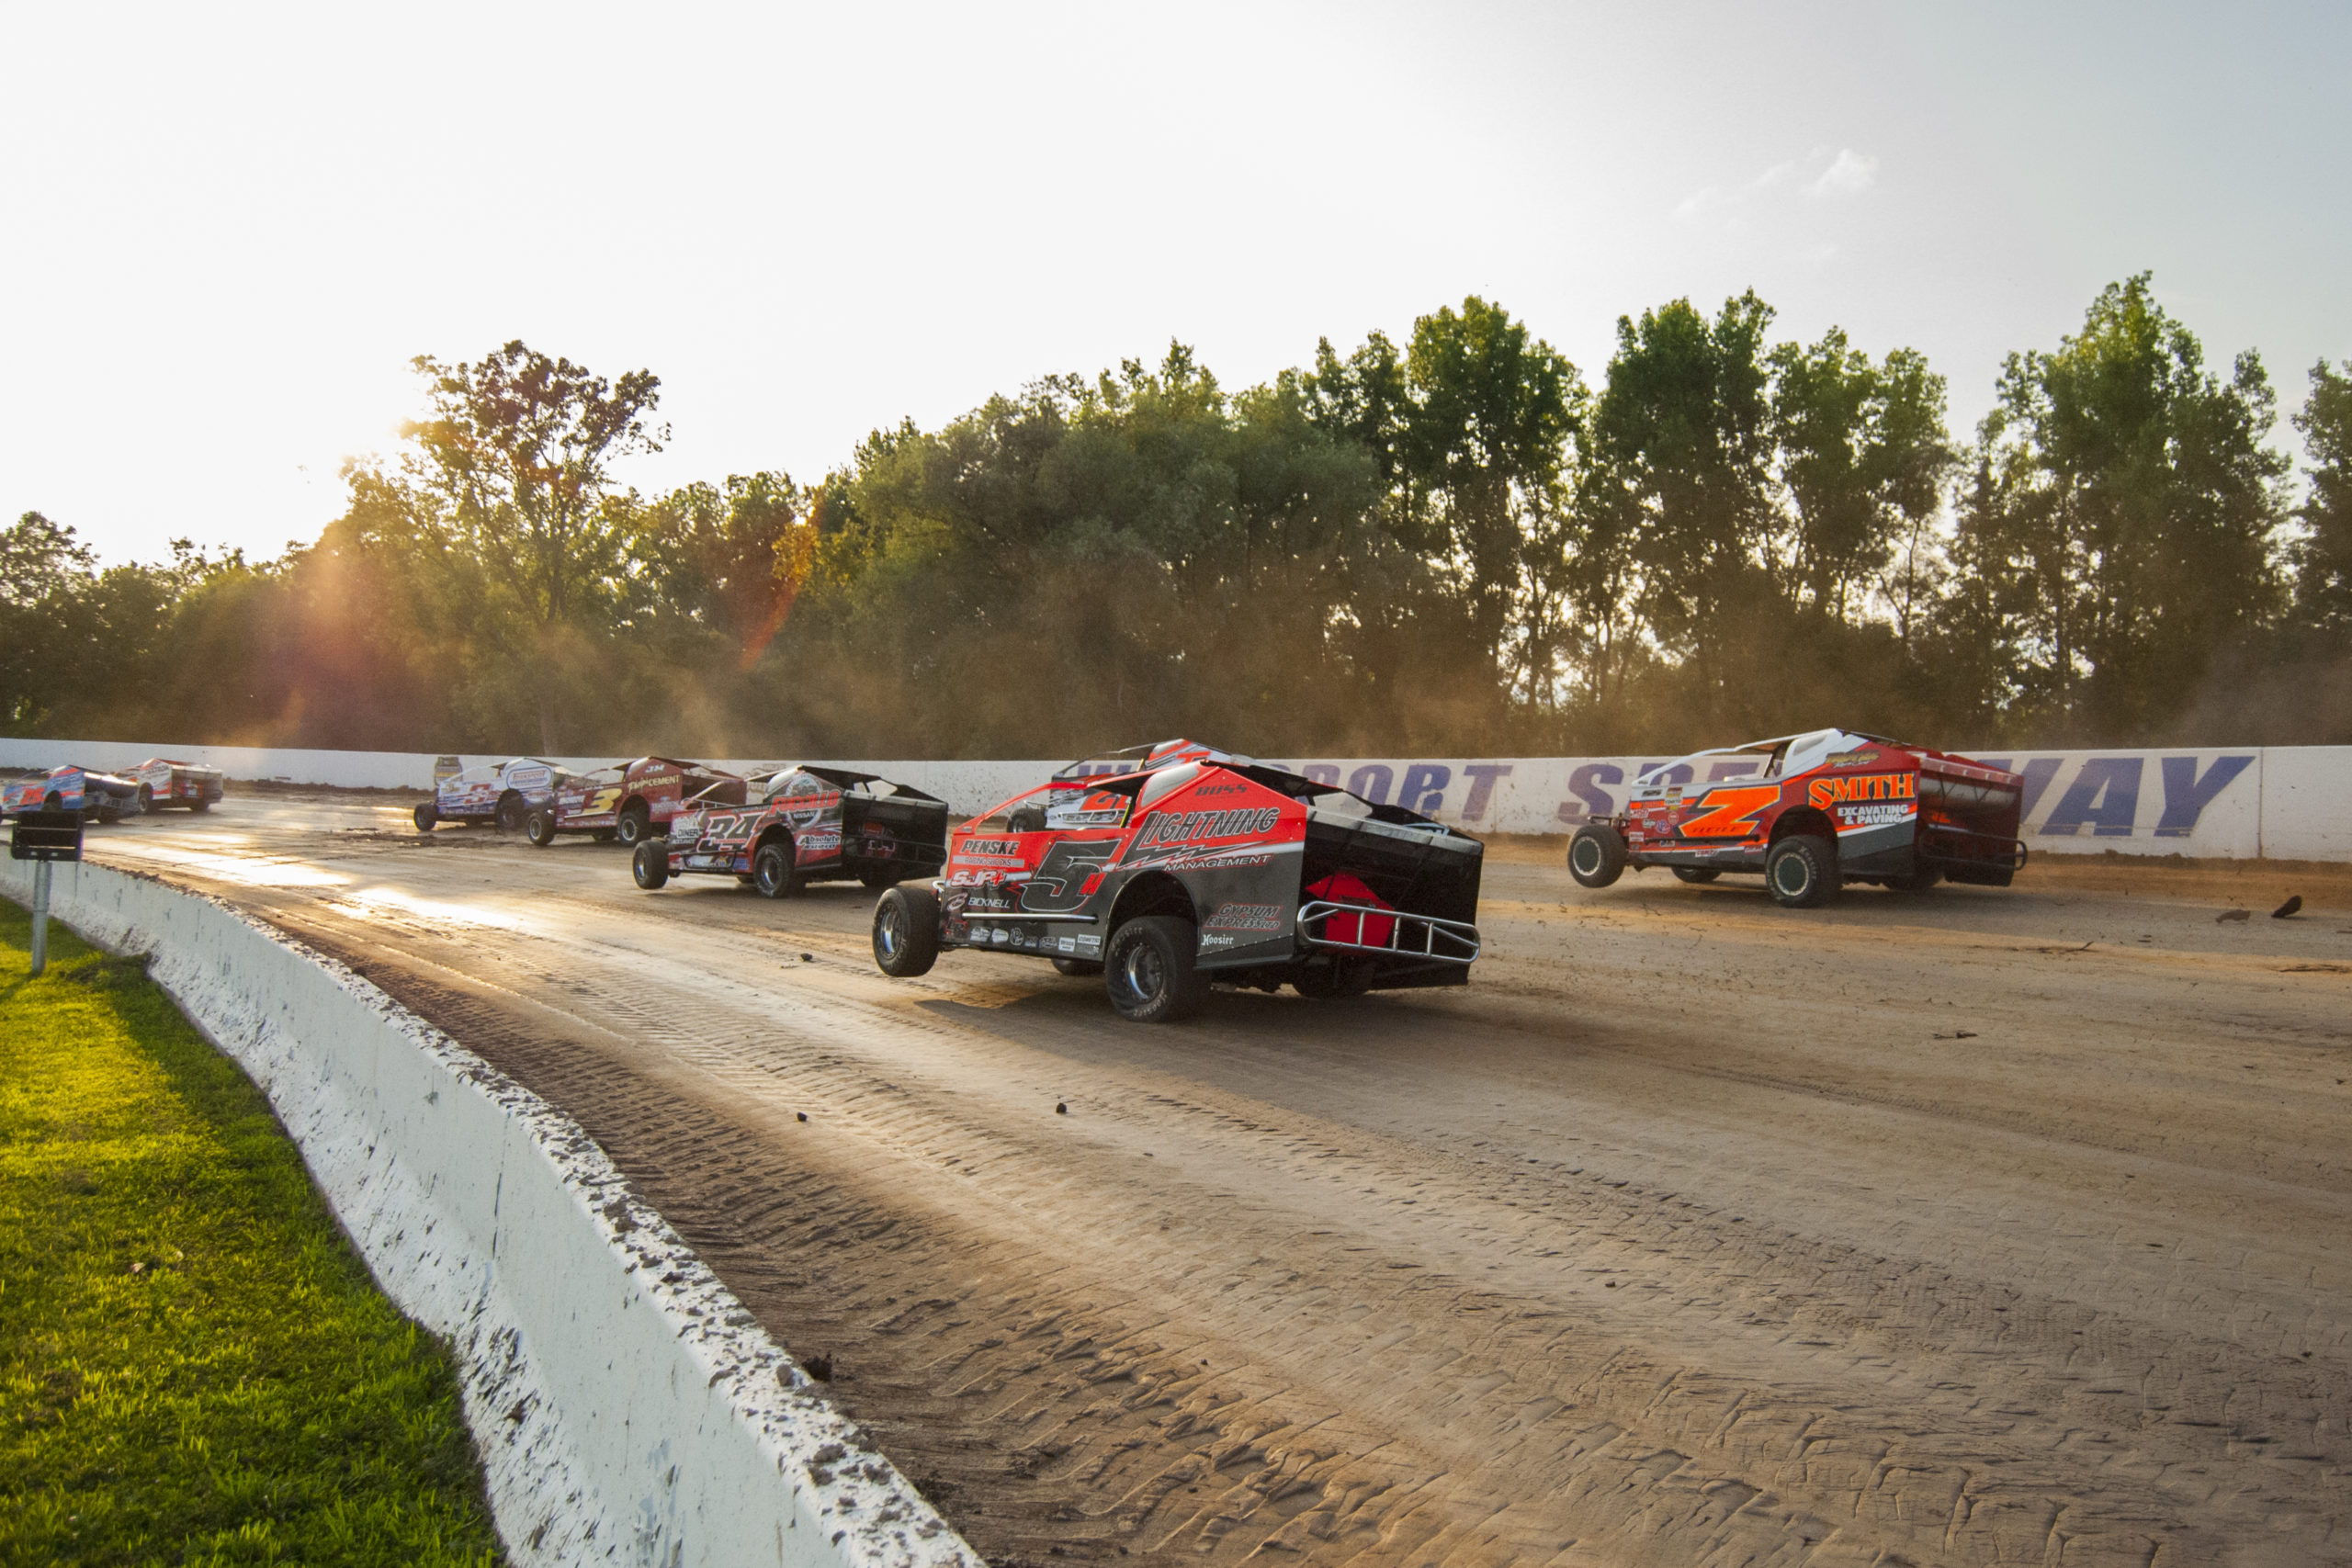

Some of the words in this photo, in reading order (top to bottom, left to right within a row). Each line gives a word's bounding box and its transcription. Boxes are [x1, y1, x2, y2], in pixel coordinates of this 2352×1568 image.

[1807, 773, 1917, 810] SMITH
[582, 787, 623, 814] 3
[768, 790, 842, 816] FUCCILLO
[793, 810, 816, 819] NISSAN
[1838, 804, 1908, 818] EXCAVATING
[1844, 815, 1855, 826] &
[1857, 813, 1904, 825] PAVING
[677, 829, 699, 837] DINER
[696, 810, 769, 853] 34
[1117, 807, 1281, 869] LIGHTNING
[960, 838, 1020, 856] PENSKE
[1163, 854, 1272, 872] MANAGEMENT
[967, 897, 1011, 908] BICKNELL
[1219, 904, 1281, 918] GYPSUM
[1200, 933, 1234, 946] Hoosier
